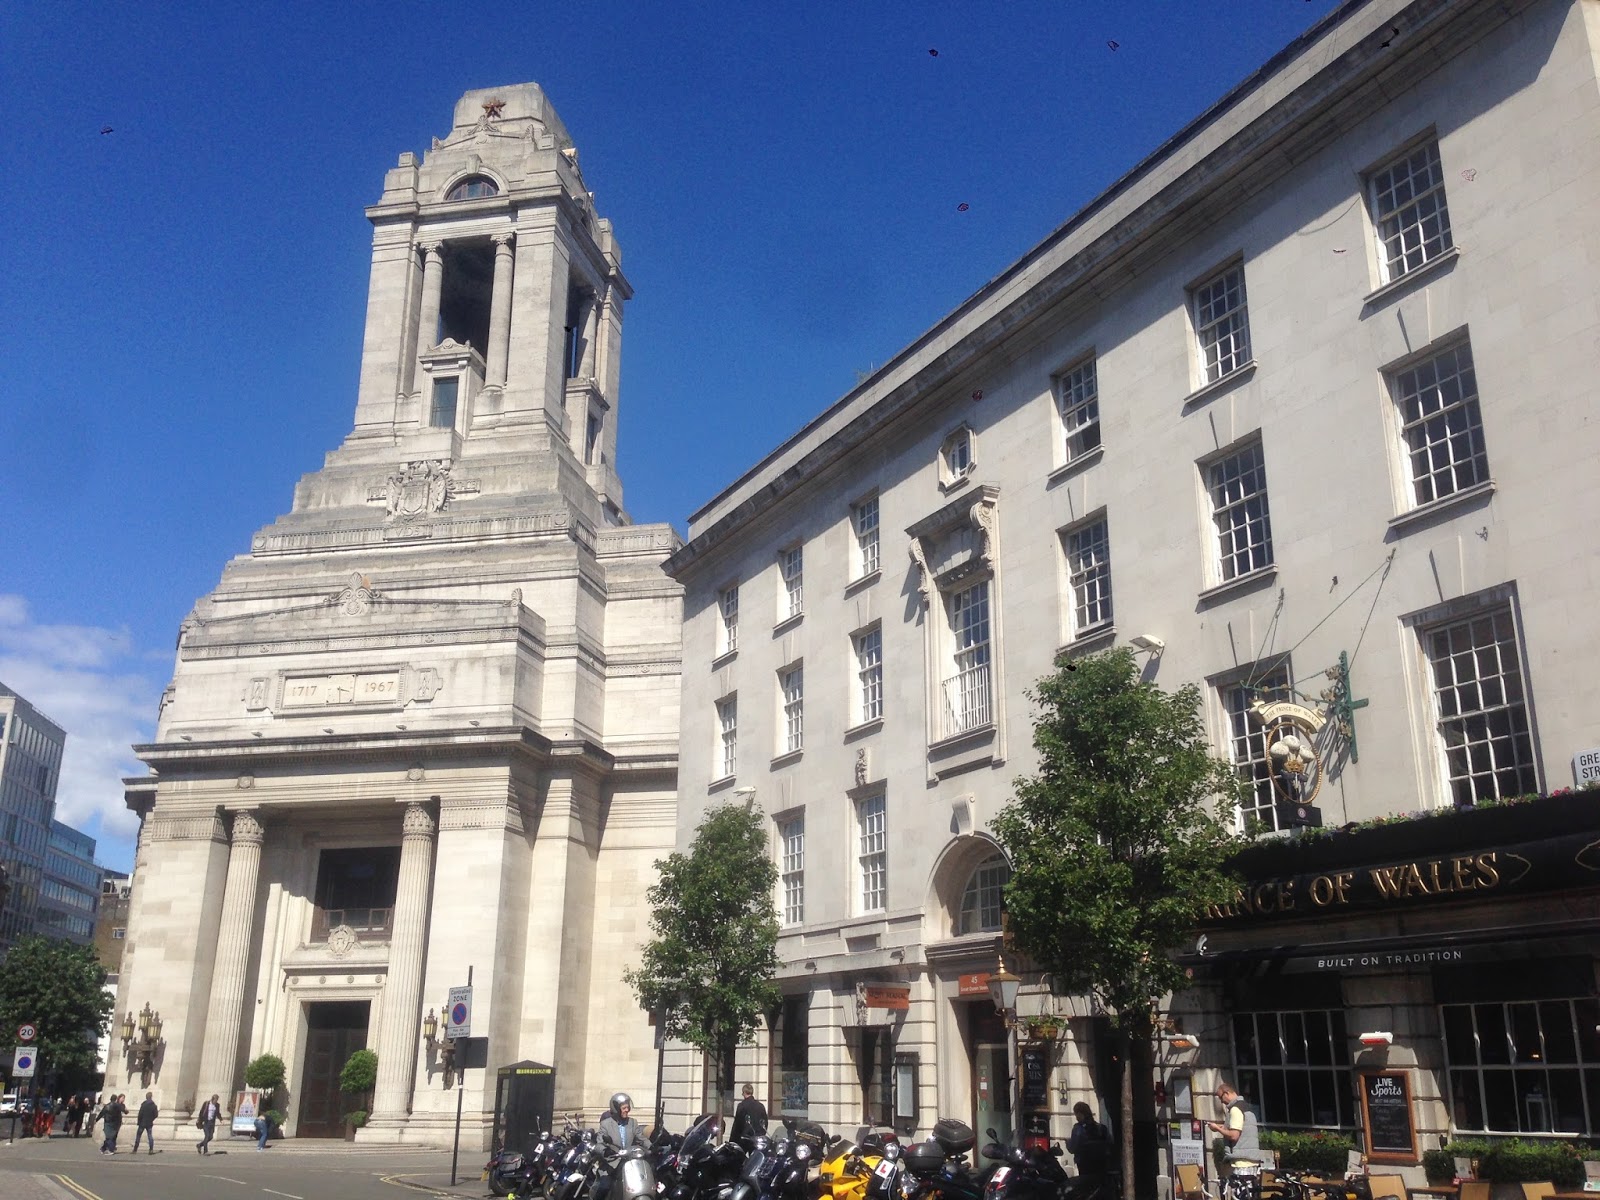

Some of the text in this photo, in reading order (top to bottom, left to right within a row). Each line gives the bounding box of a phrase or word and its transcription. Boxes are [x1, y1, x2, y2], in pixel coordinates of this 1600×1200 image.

[292, 685, 317, 696] 1717
[365, 681, 394, 692] 1967
[1580, 752, 1599, 766] GRE
[1309, 871, 1353, 907] OF
[1369, 851, 1499, 900] WALES
[1318, 950, 1462, 968] BUILT ON TRADITION
[971, 975, 978, 984] 45
[453, 994, 468, 1002] ZONE
[1377, 1078, 1392, 1087] LIVE
[1371, 1084, 1402, 1098] Sports
[880, 1164, 887, 1174] L
